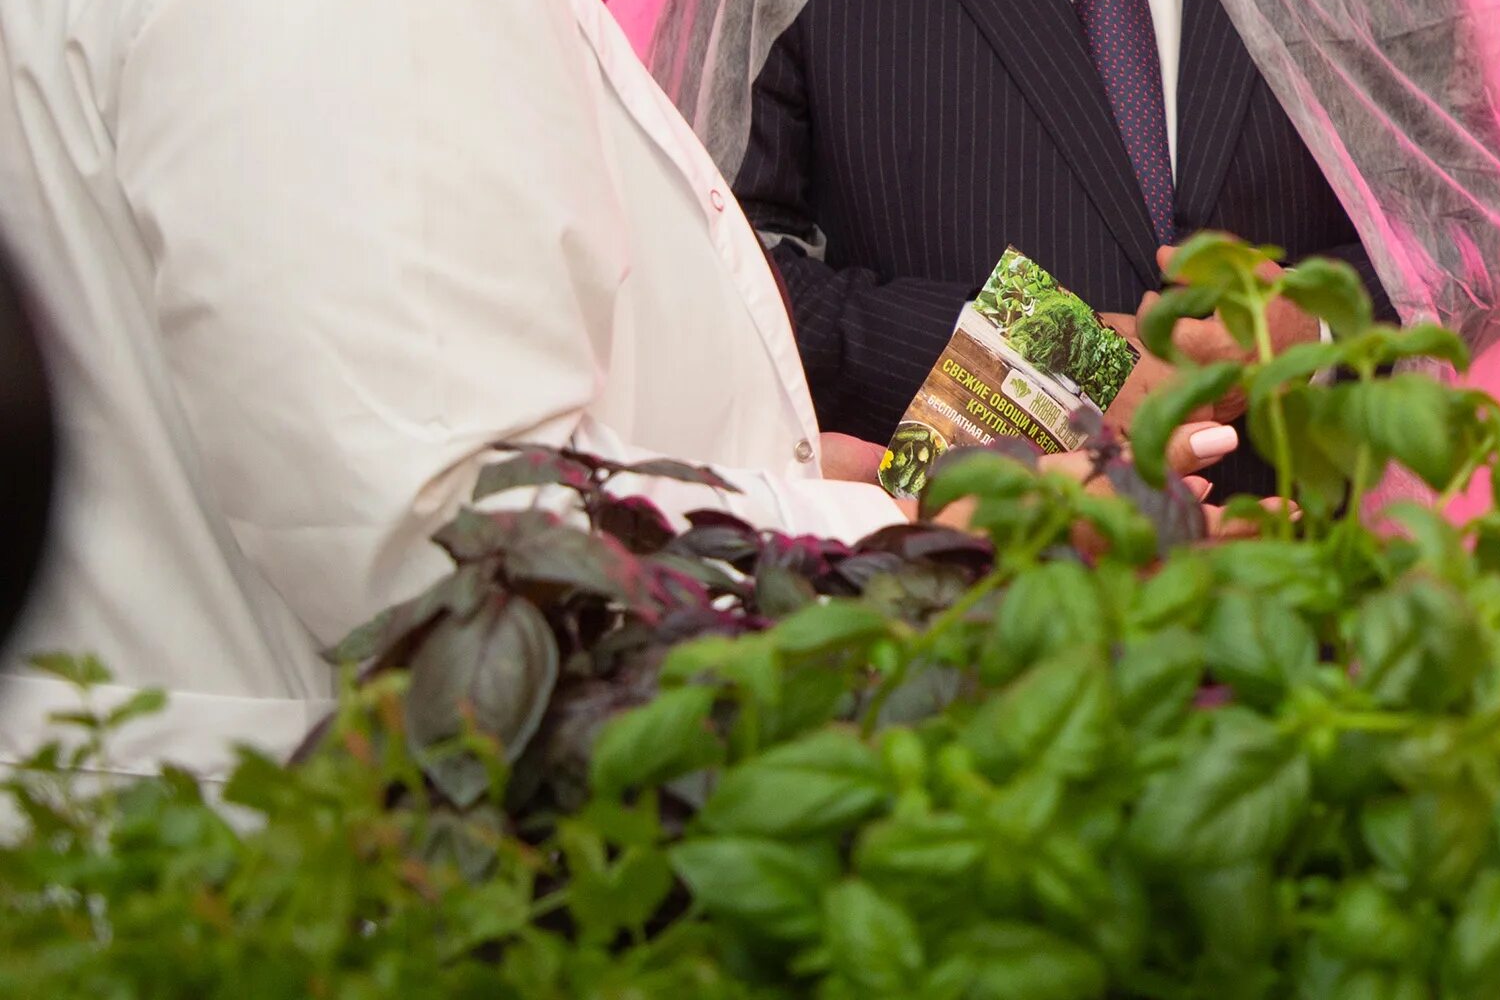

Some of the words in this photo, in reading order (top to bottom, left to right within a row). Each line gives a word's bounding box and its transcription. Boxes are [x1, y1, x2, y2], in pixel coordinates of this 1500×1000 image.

[927, 395, 983, 439] БЕСПЛАТНАЯ
[943, 359, 991, 399] СВЕЖИЕ
[989, 393, 1031, 430] ОВОЩИ
[1028, 423, 1039, 438] И
[1029, 391, 1061, 428] ЖИВАЯ
